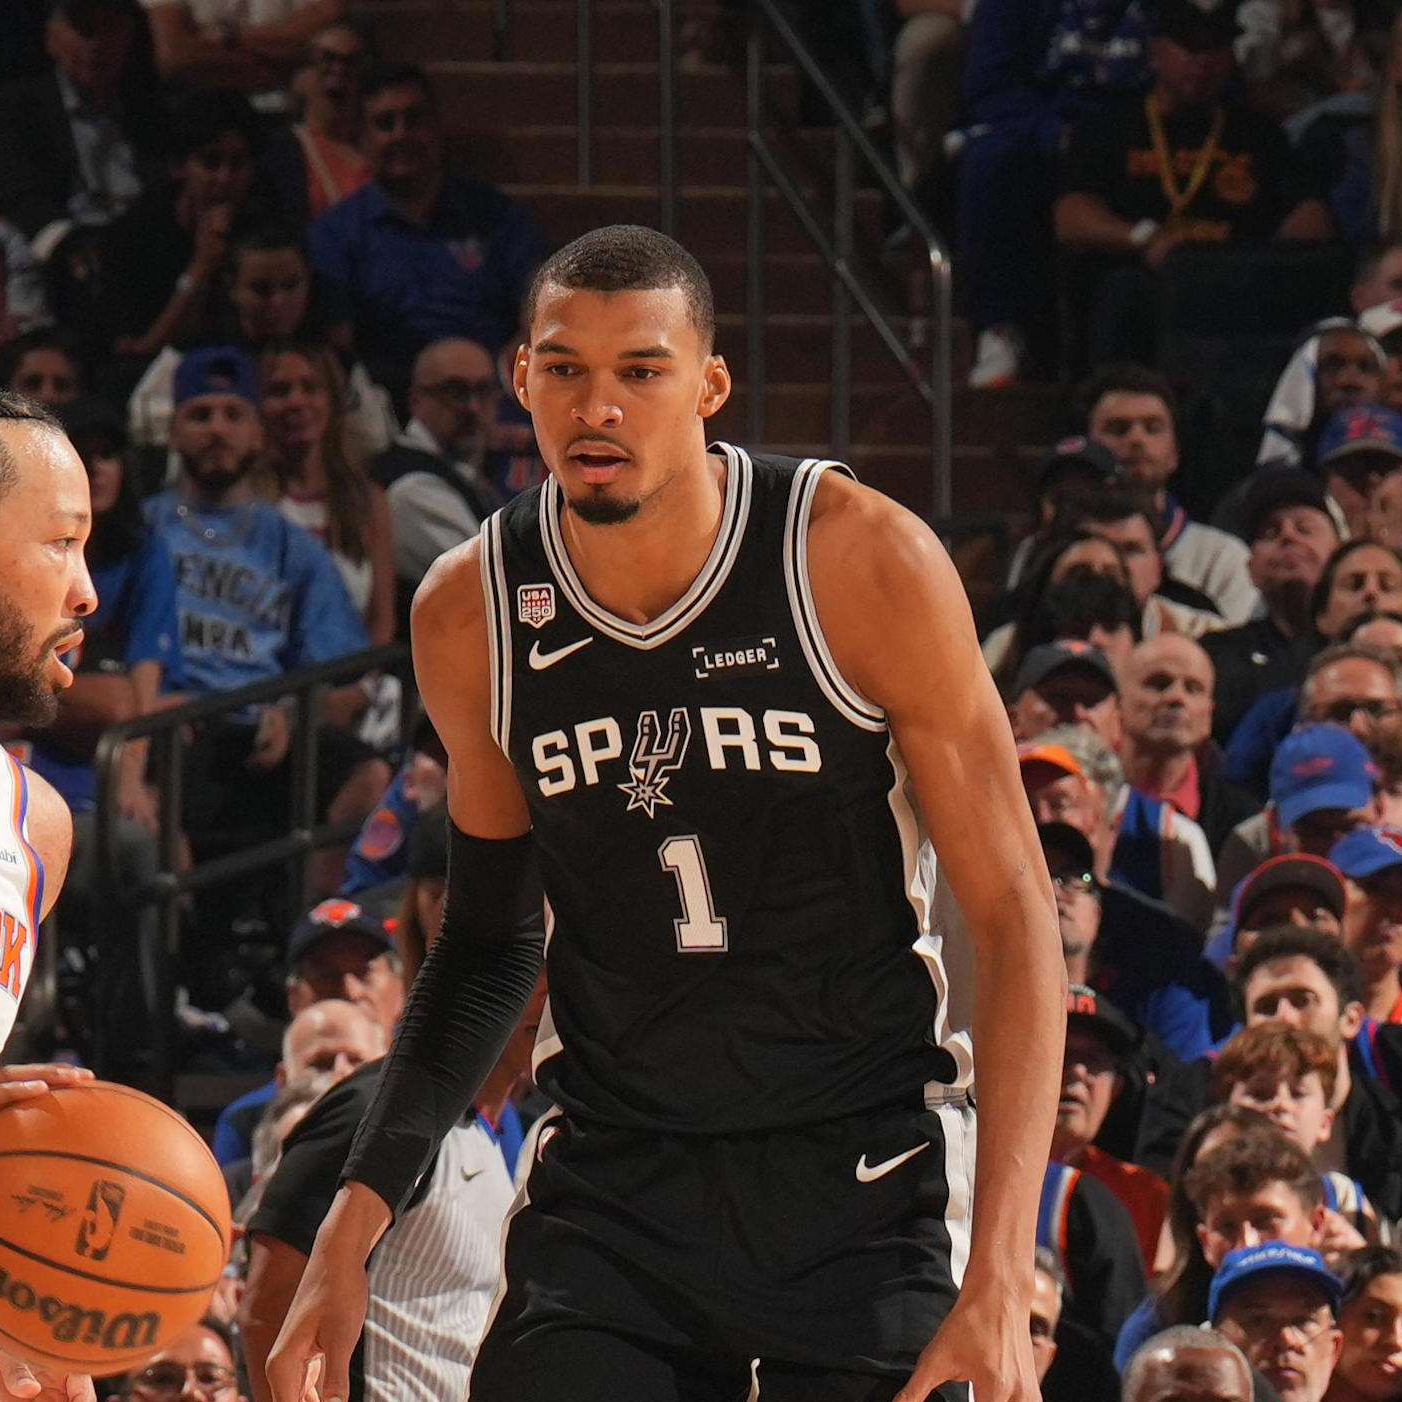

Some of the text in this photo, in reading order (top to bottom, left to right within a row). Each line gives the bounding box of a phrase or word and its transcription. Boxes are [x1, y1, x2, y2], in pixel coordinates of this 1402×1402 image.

[521, 590, 549, 601] USA
[521, 605, 553, 619] 250
[704, 648, 767, 670] LEDGER
[657, 834, 729, 953] 1
